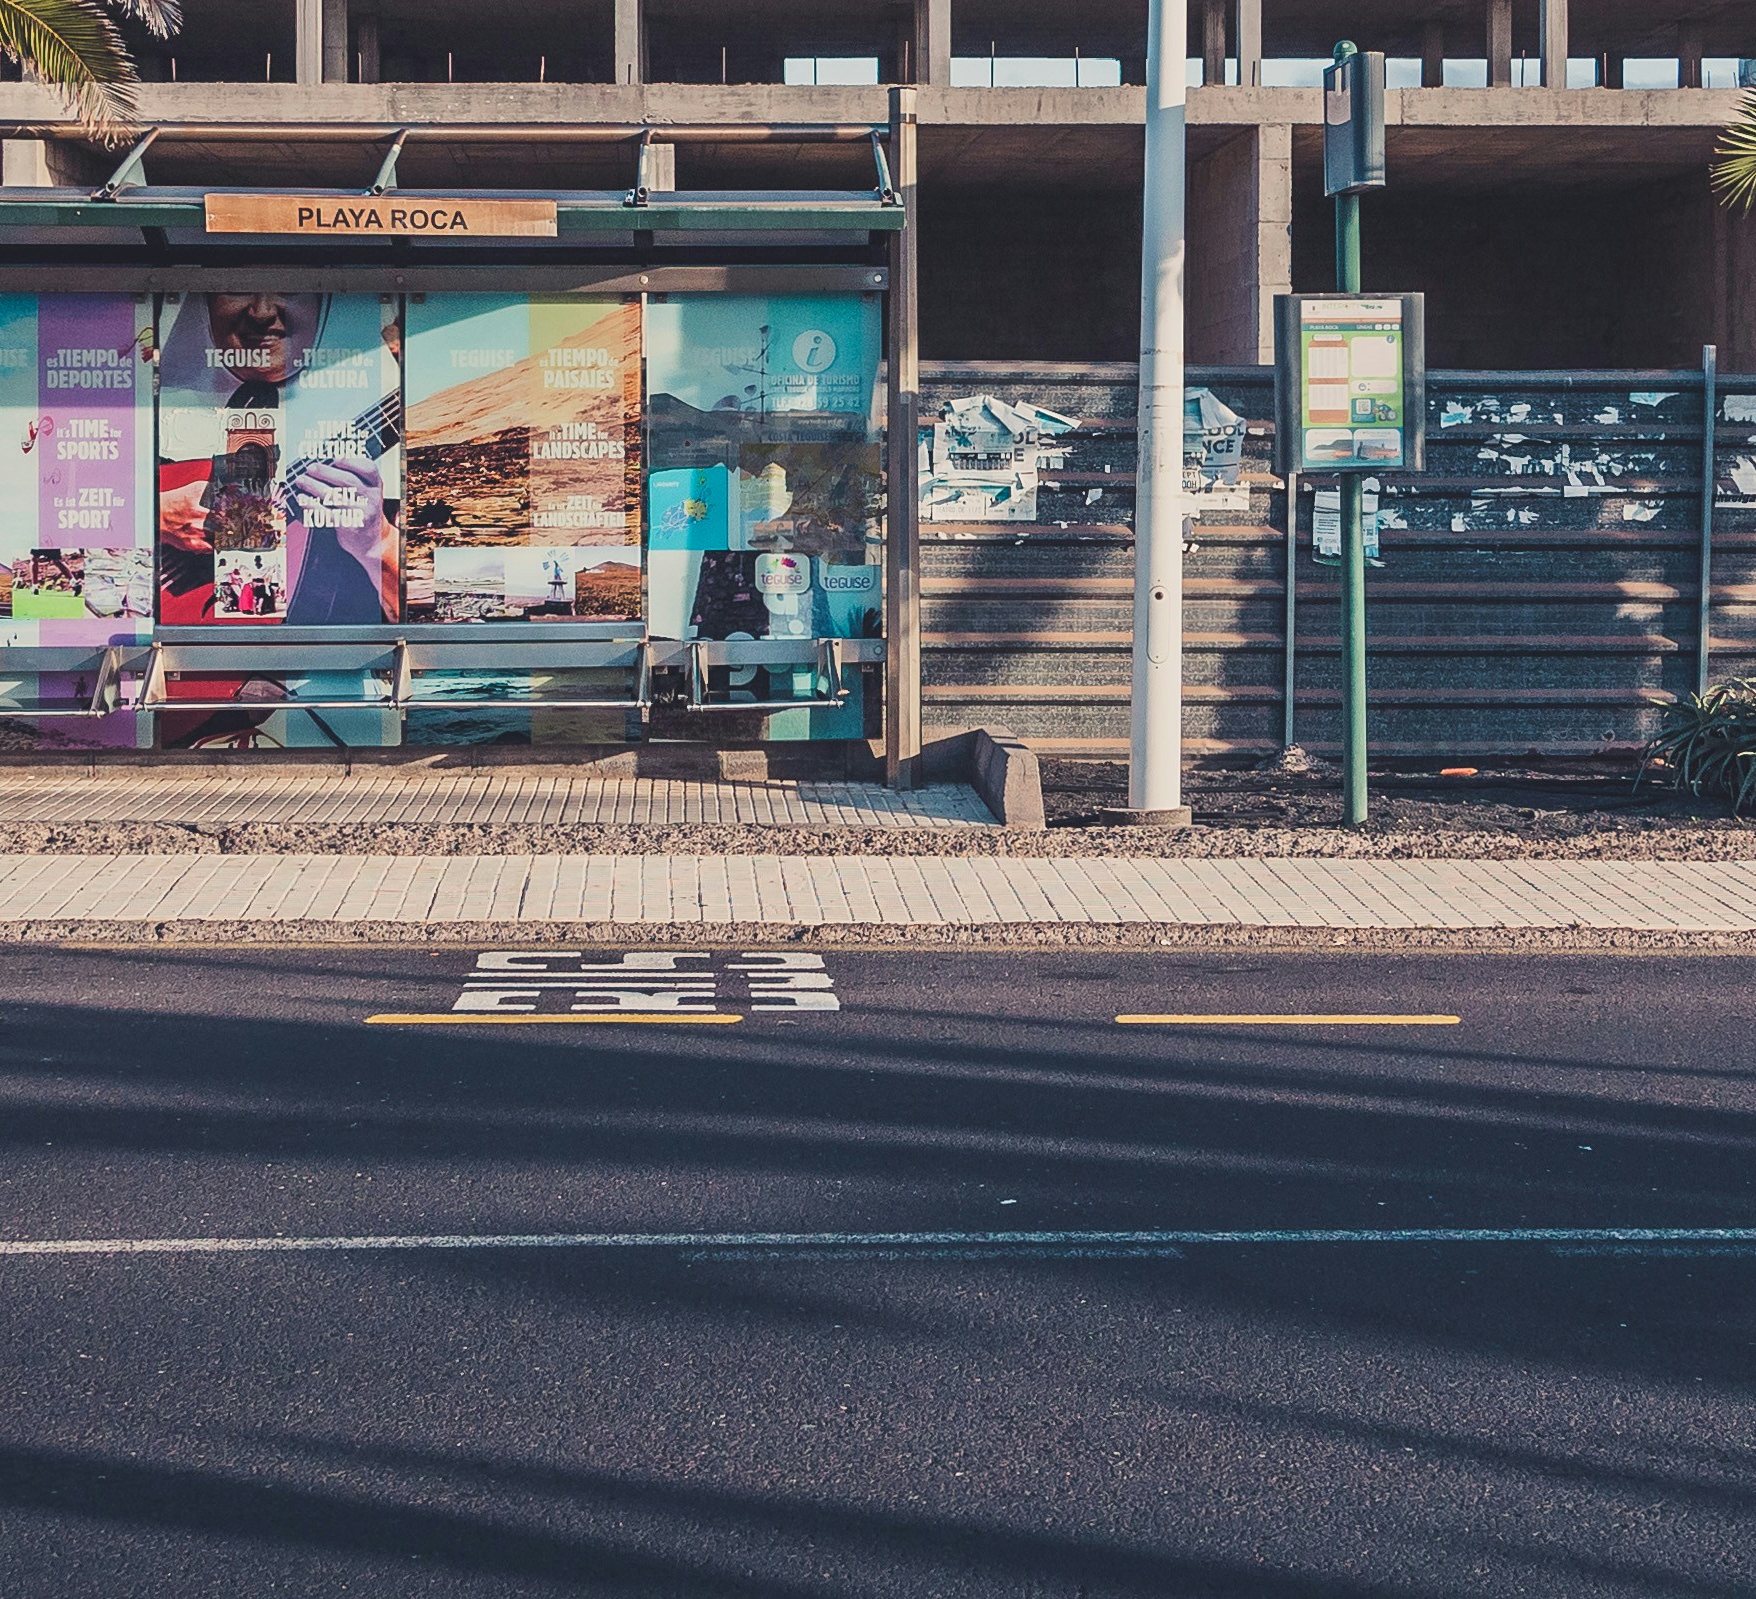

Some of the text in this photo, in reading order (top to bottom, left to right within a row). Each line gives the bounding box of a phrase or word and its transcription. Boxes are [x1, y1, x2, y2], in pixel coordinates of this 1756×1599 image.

[298, 207, 468, 230] PLAYA ROCA
[56, 349, 118, 367] TIEMPO
[205, 349, 272, 368] TEGUISE
[302, 348, 363, 367] TIEMPO
[450, 349, 515, 368] TEGUISE
[548, 348, 608, 367] TIEMPO
[46, 370, 132, 389] DEPORTES
[299, 369, 369, 389] CULTURA
[821, 374, 860, 385] TURISMO
[69, 419, 109, 438] TIME
[318, 420, 356, 439] TIME
[561, 422, 597, 440] TIME
[57, 441, 119, 460] SPORTS
[298, 440, 366, 459] CULTURE
[533, 441, 625, 459] LANDSCAPES
[78, 487, 114, 507] ZEIT
[322, 486, 358, 506] ZEIT
[567, 495, 593, 510] ZEIT
[58, 509, 111, 529] SPORT
[303, 508, 365, 528] KULTUR
